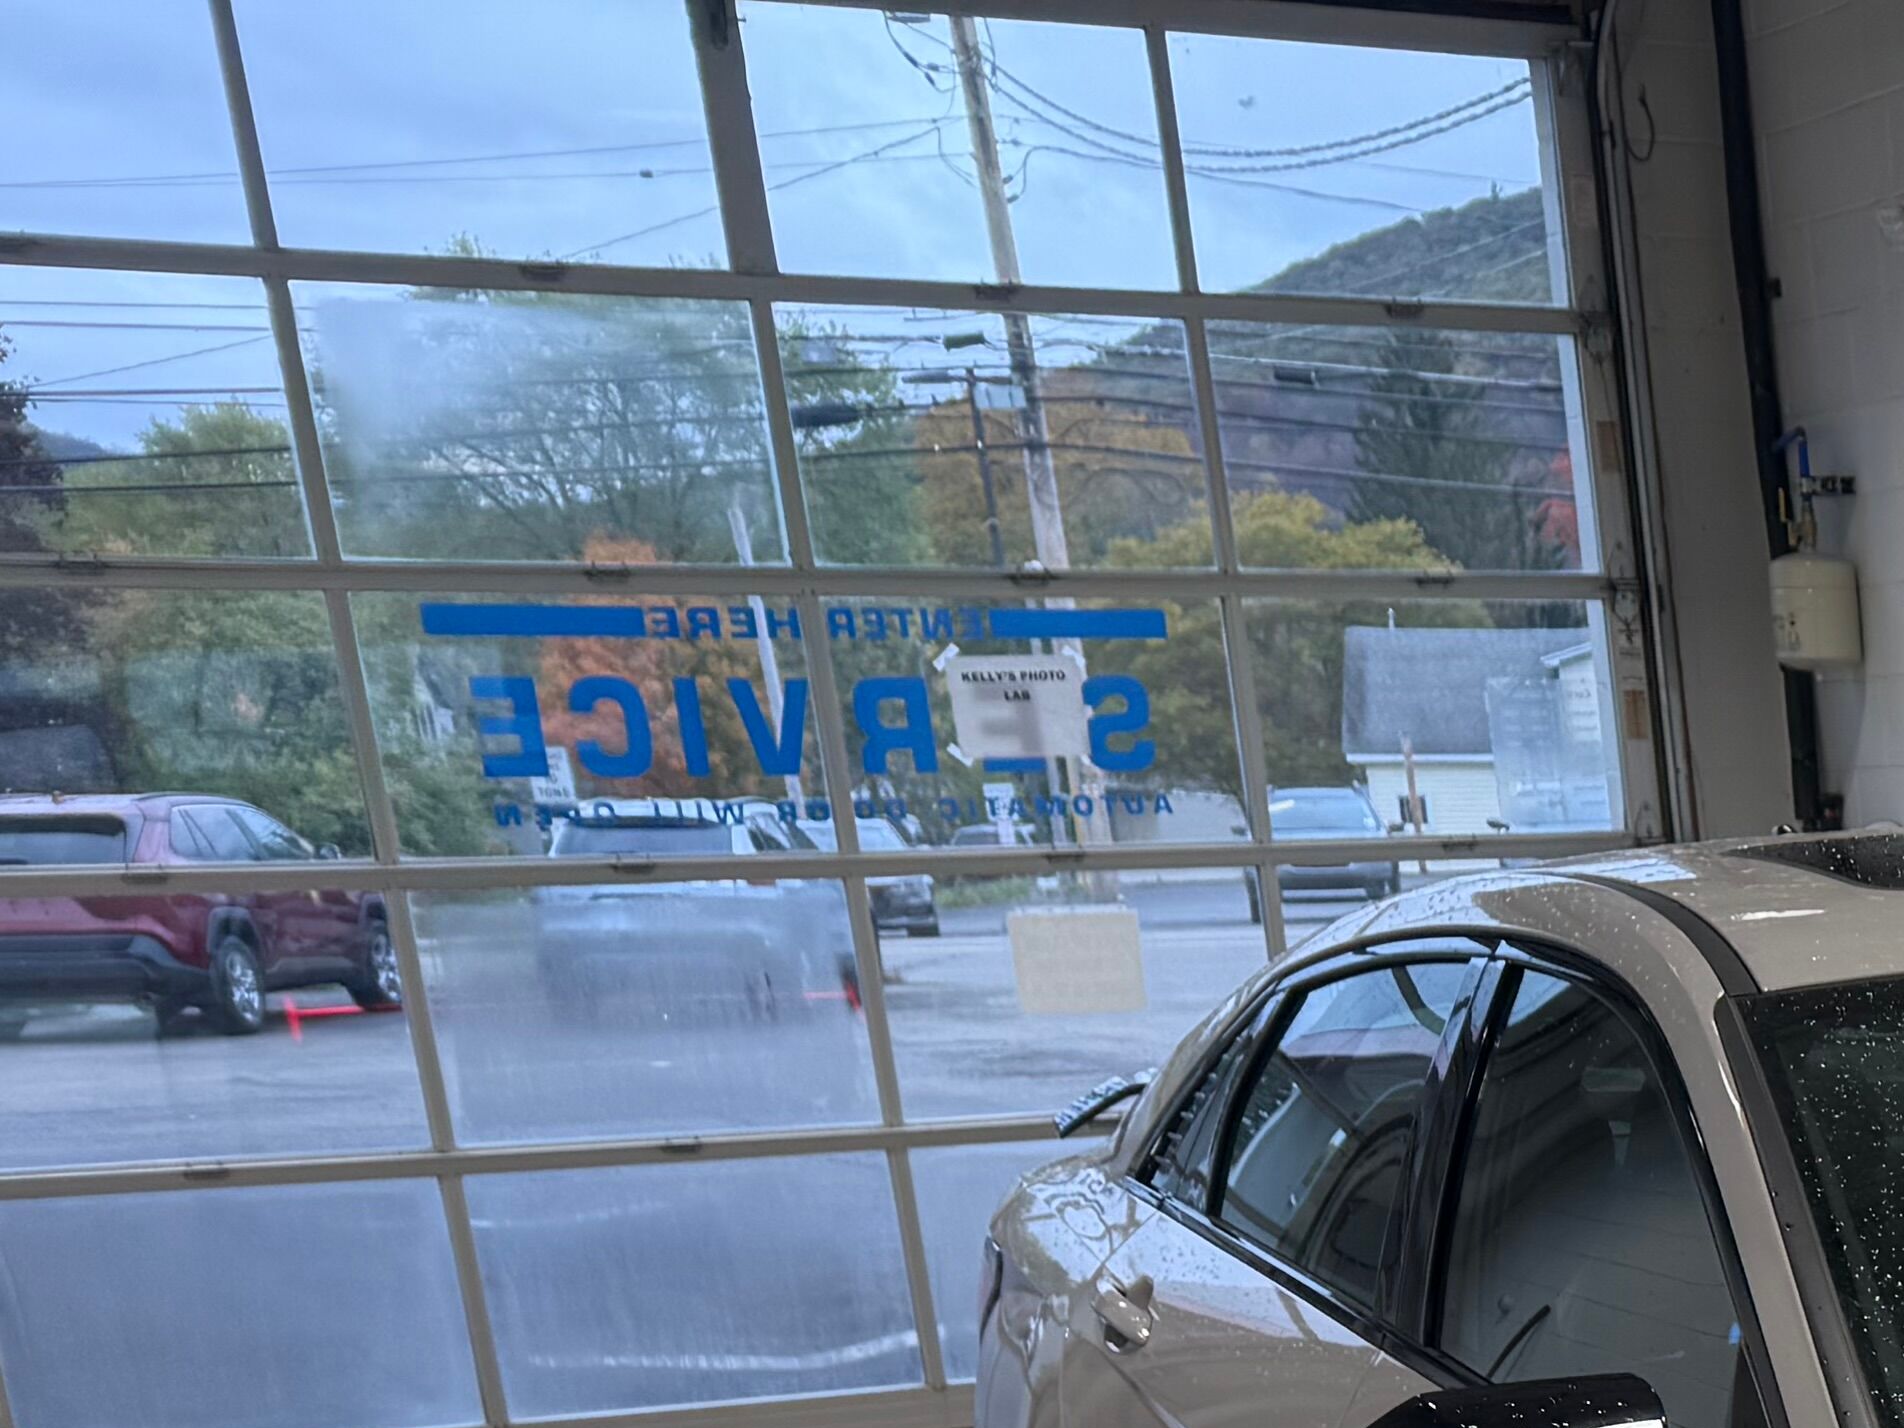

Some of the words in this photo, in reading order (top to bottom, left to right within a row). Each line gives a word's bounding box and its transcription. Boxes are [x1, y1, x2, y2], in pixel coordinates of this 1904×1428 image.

[961, 670, 1017, 683] KELLY'S
[1020, 669, 1066, 682] PHOTO
[1003, 690, 1031, 702] LAB
